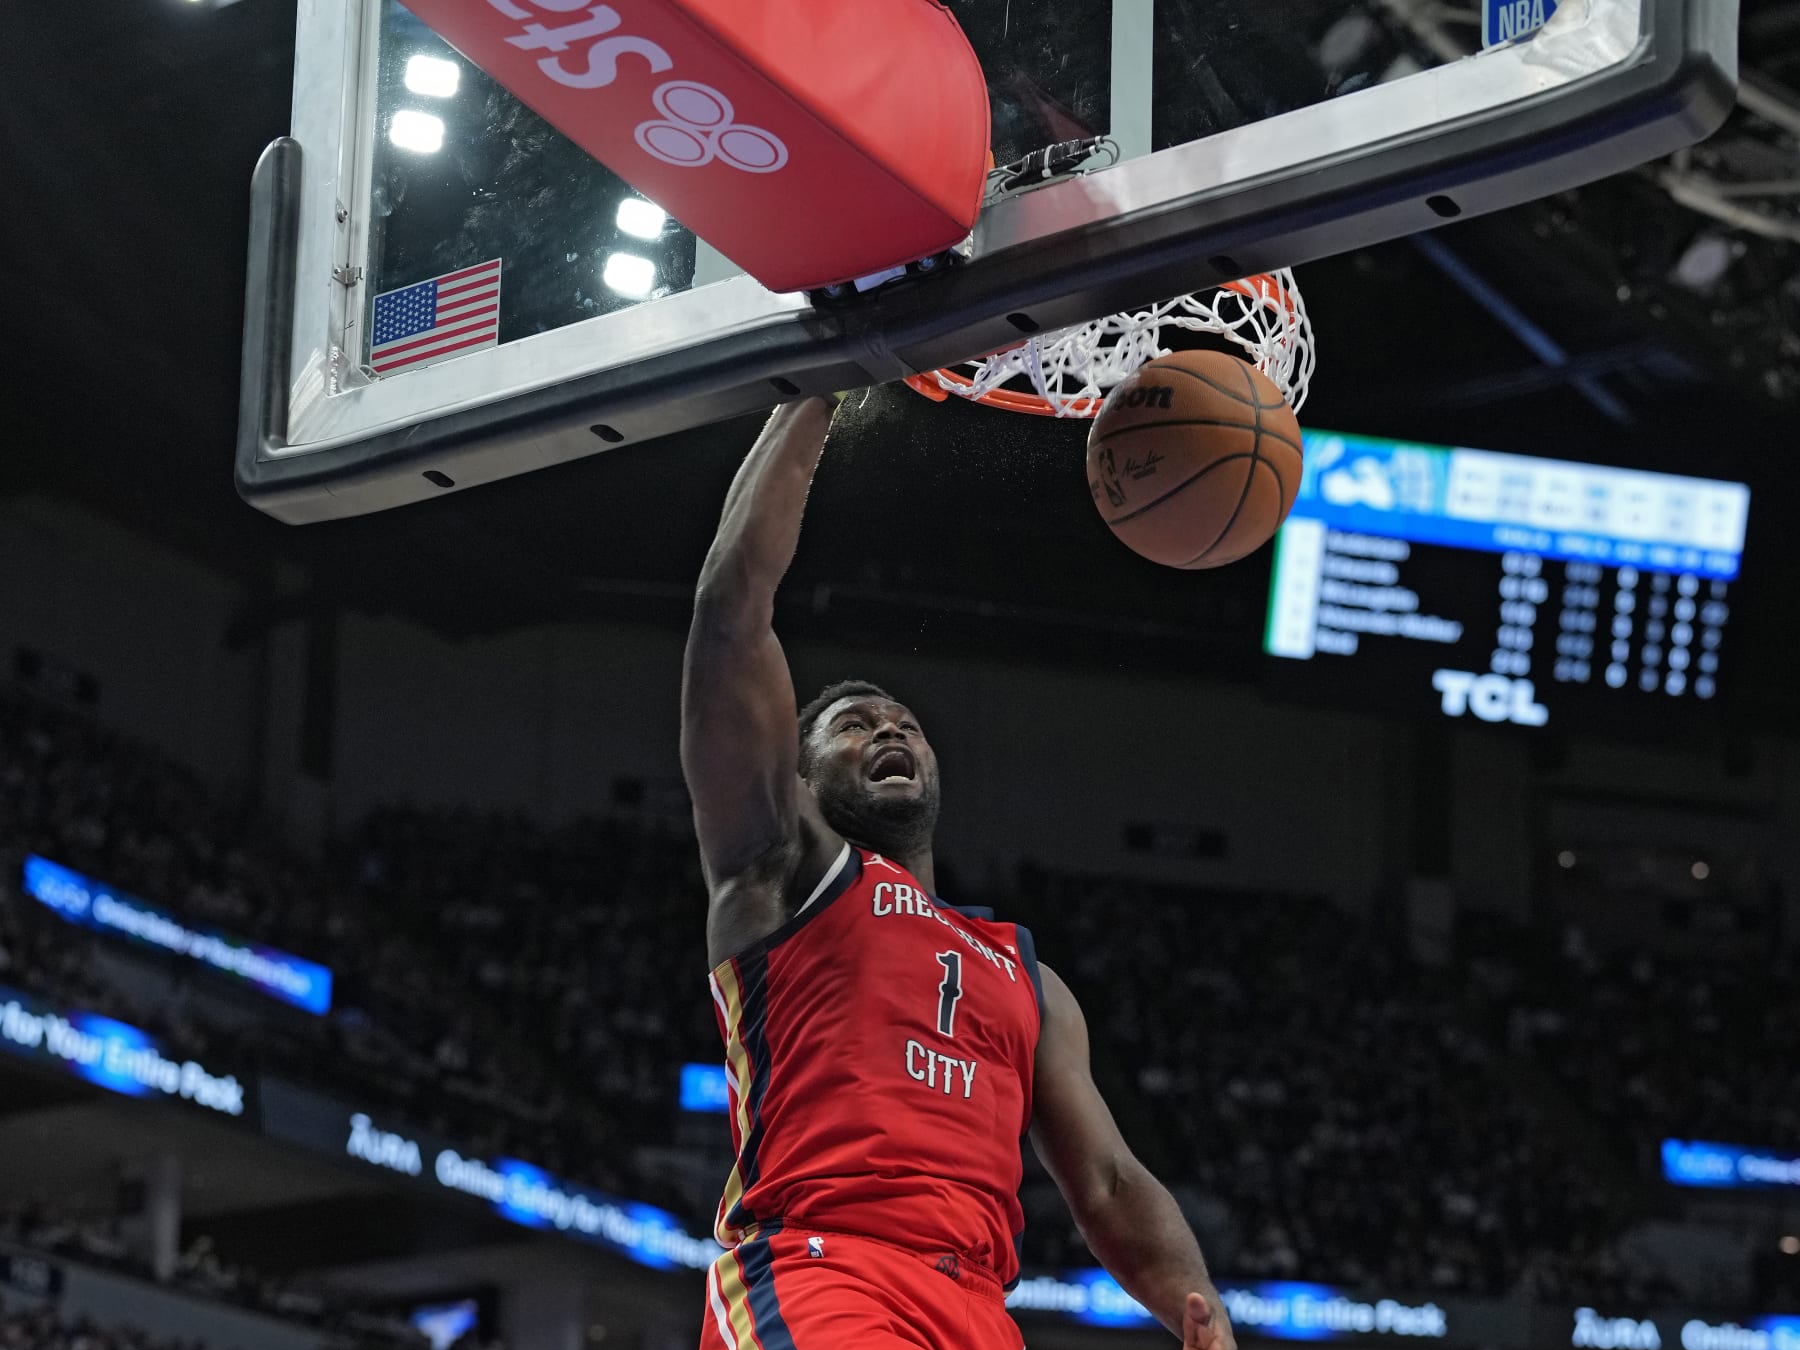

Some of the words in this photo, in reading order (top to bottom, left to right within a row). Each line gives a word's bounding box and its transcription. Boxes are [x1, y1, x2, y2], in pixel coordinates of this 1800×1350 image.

[1498, 0, 1545, 41] NBA
[1432, 668, 1549, 727] TCL
[935, 950, 963, 1038] 1
[906, 1039, 977, 1098] CITY
